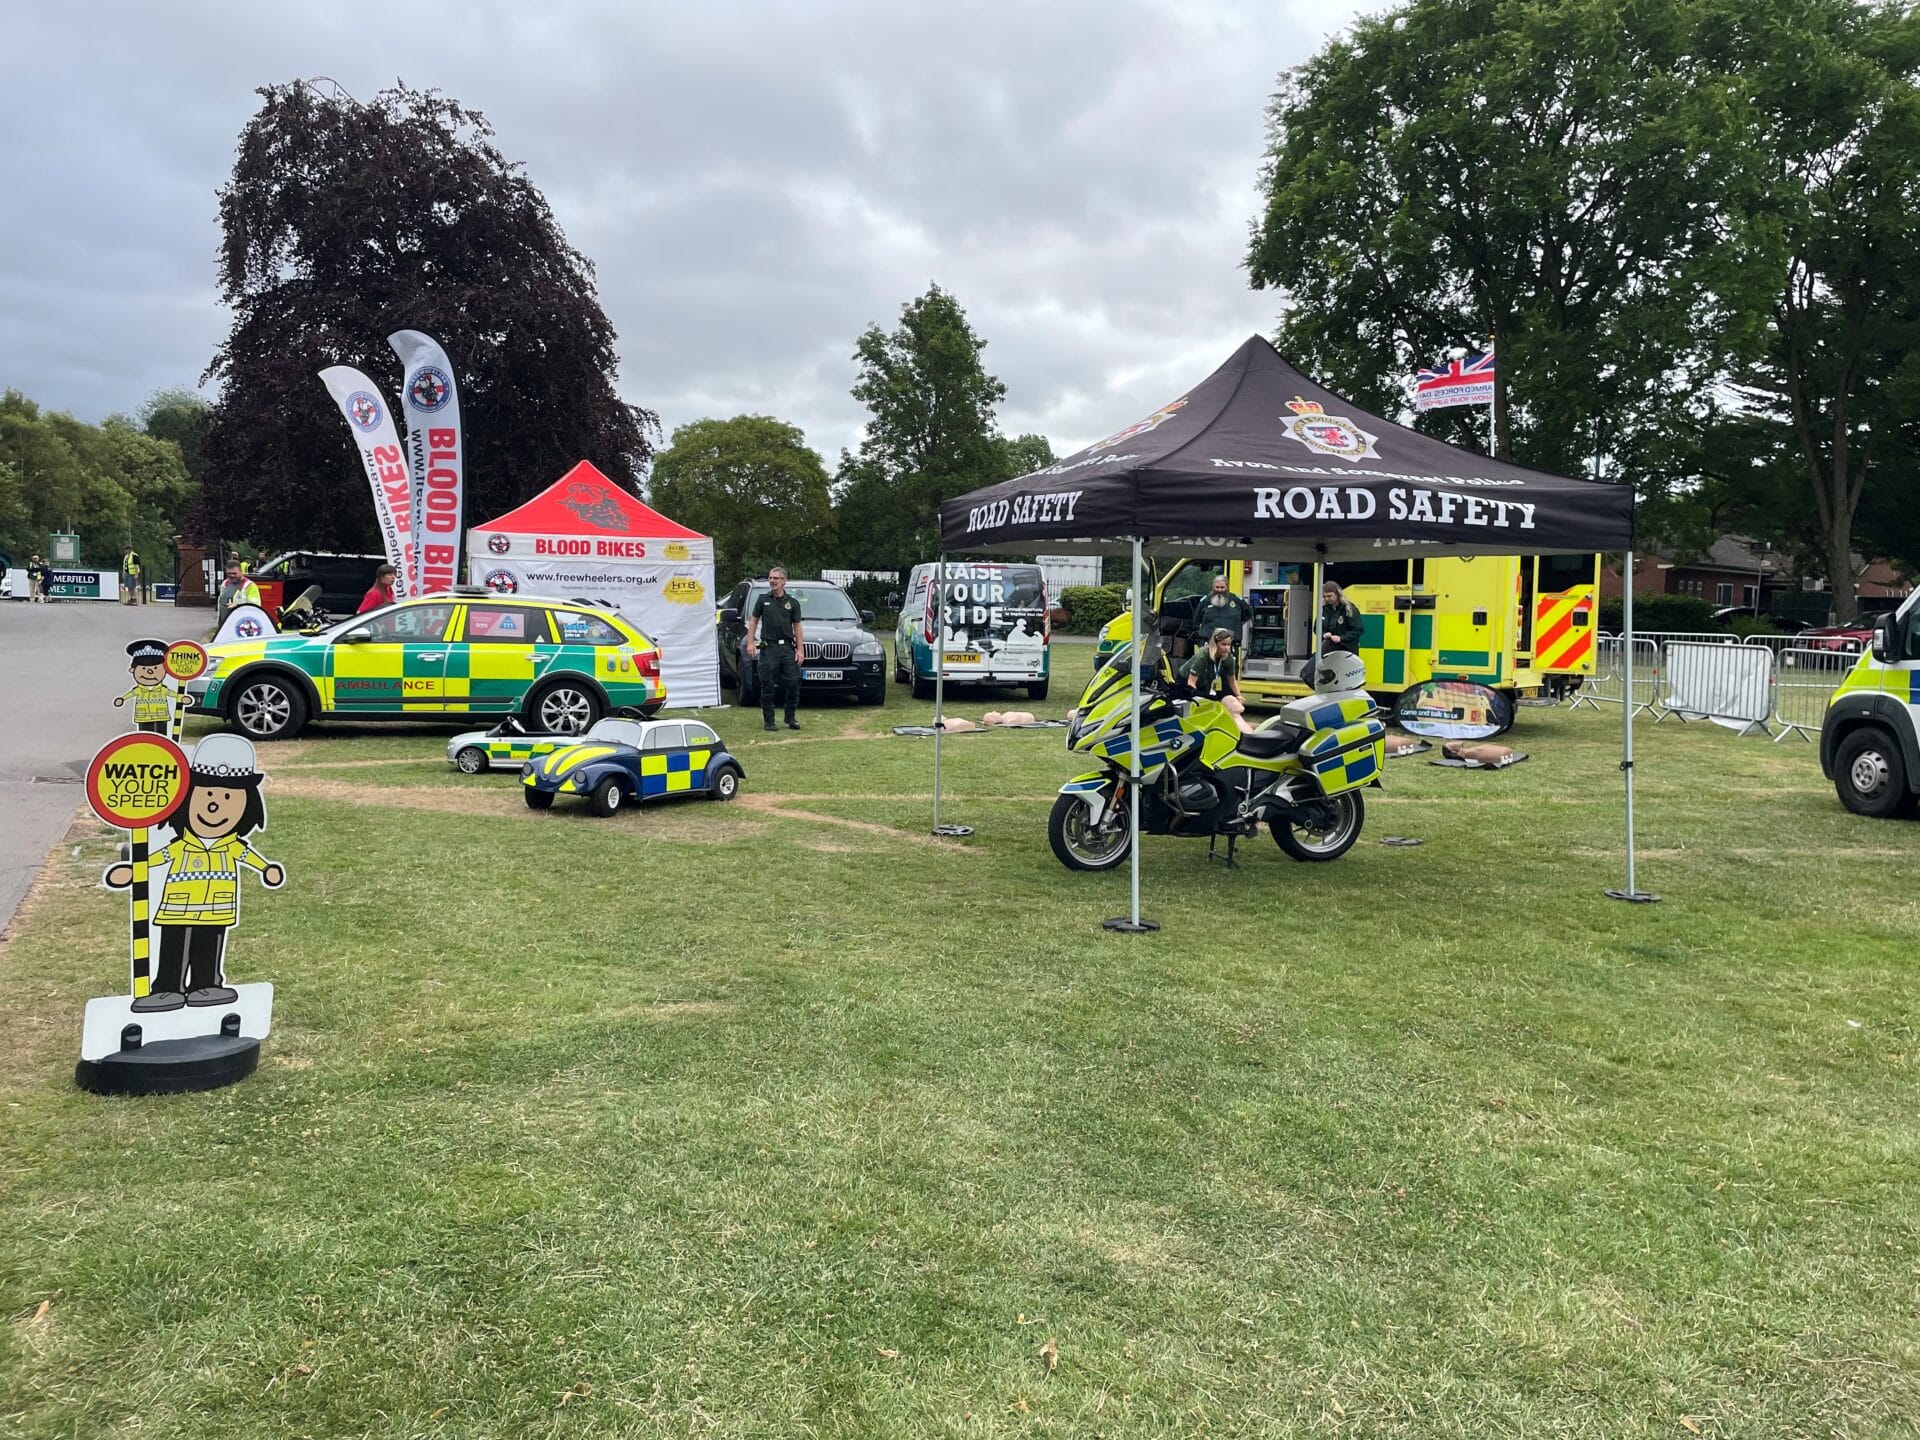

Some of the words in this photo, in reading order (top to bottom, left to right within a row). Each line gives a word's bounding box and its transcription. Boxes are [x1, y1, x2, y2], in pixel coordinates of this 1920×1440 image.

[1211, 458, 1279, 470] Avon
[1281, 465, 1332, 475] and
[426, 428, 458, 533] BLOOD
[966, 500, 1010, 533] ROAD
[1011, 491, 1083, 525] SAFETY
[1253, 486, 1377, 520] ROAD
[1388, 487, 1536, 529] SAFETY
[535, 538, 591, 555] BLOOD
[596, 540, 646, 558] BIKES
[422, 543, 455, 596] BIK
[938, 565, 1003, 581] RAISE
[53, 575, 95, 584] MERFIELD
[526, 573, 658, 586] www.freewheelers.org.uk
[936, 583, 1005, 603] YOUR
[938, 606, 1004, 625] RIDE
[170, 651, 200, 660] THINK
[336, 680, 435, 690] AMBULANCE
[104, 763, 178, 780] WATCH
[111, 779, 169, 795] YOUR
[106, 794, 169, 808] SPEED
